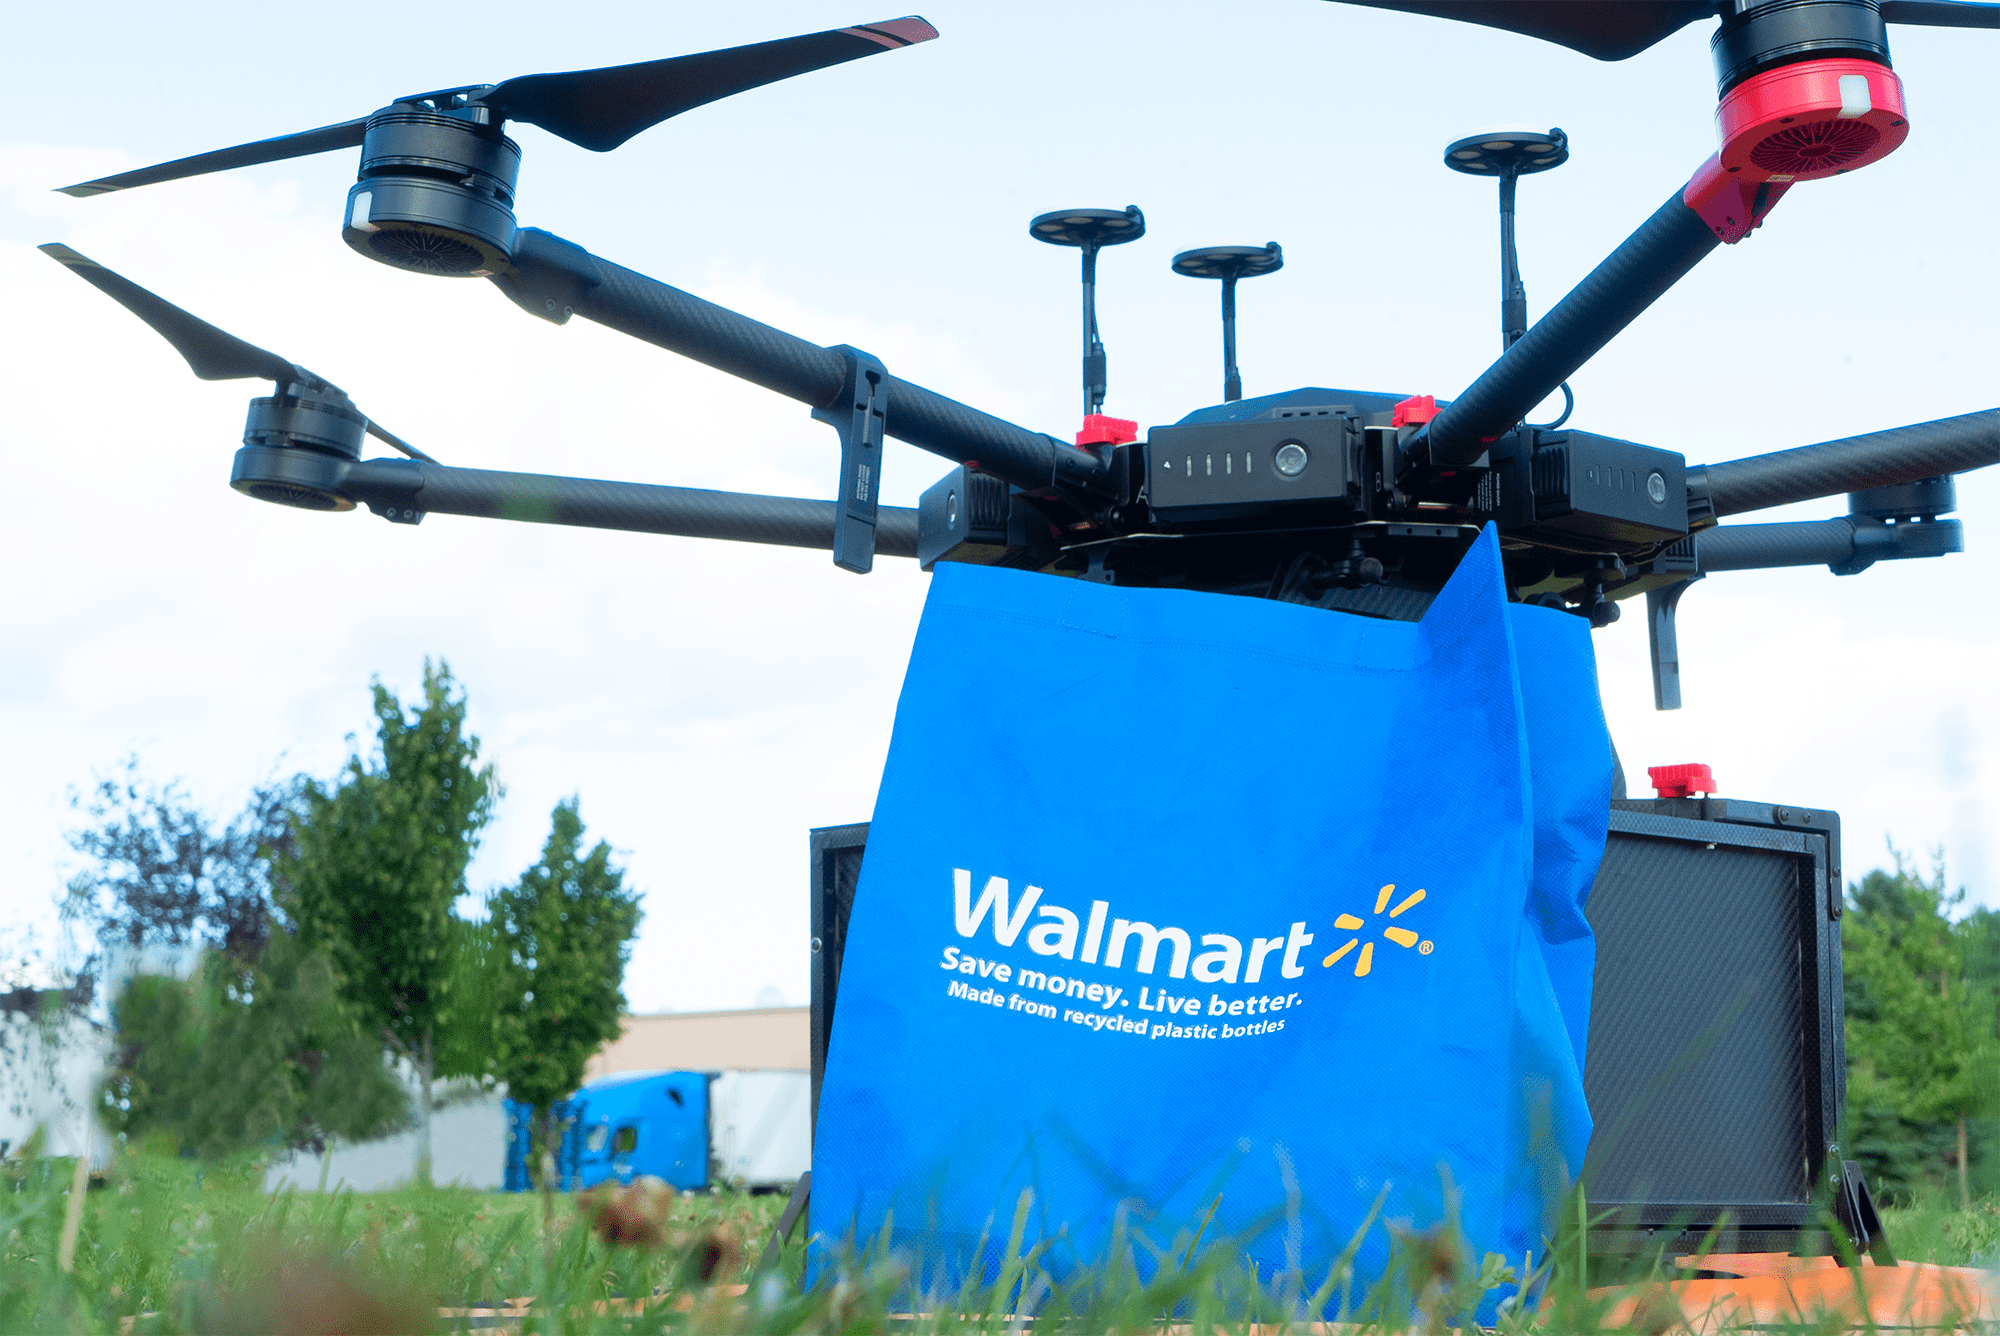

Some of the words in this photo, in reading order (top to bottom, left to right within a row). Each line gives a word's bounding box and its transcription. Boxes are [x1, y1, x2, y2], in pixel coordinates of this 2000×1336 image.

[1375, 471, 1382, 493] B
[953, 867, 1314, 983] Walmart
[940, 946, 1011, 983] Save
[1017, 969, 1129, 1010] money.
[1137, 986, 1202, 1016] Live
[1207, 992, 1303, 1017] better.
[946, 979, 1005, 1008] Made
[1009, 993, 1058, 1020] from
[1063, 1009, 1149, 1035] recycled
[1150, 1021, 1217, 1040] plastic
[1221, 1019, 1286, 1039] bottles
